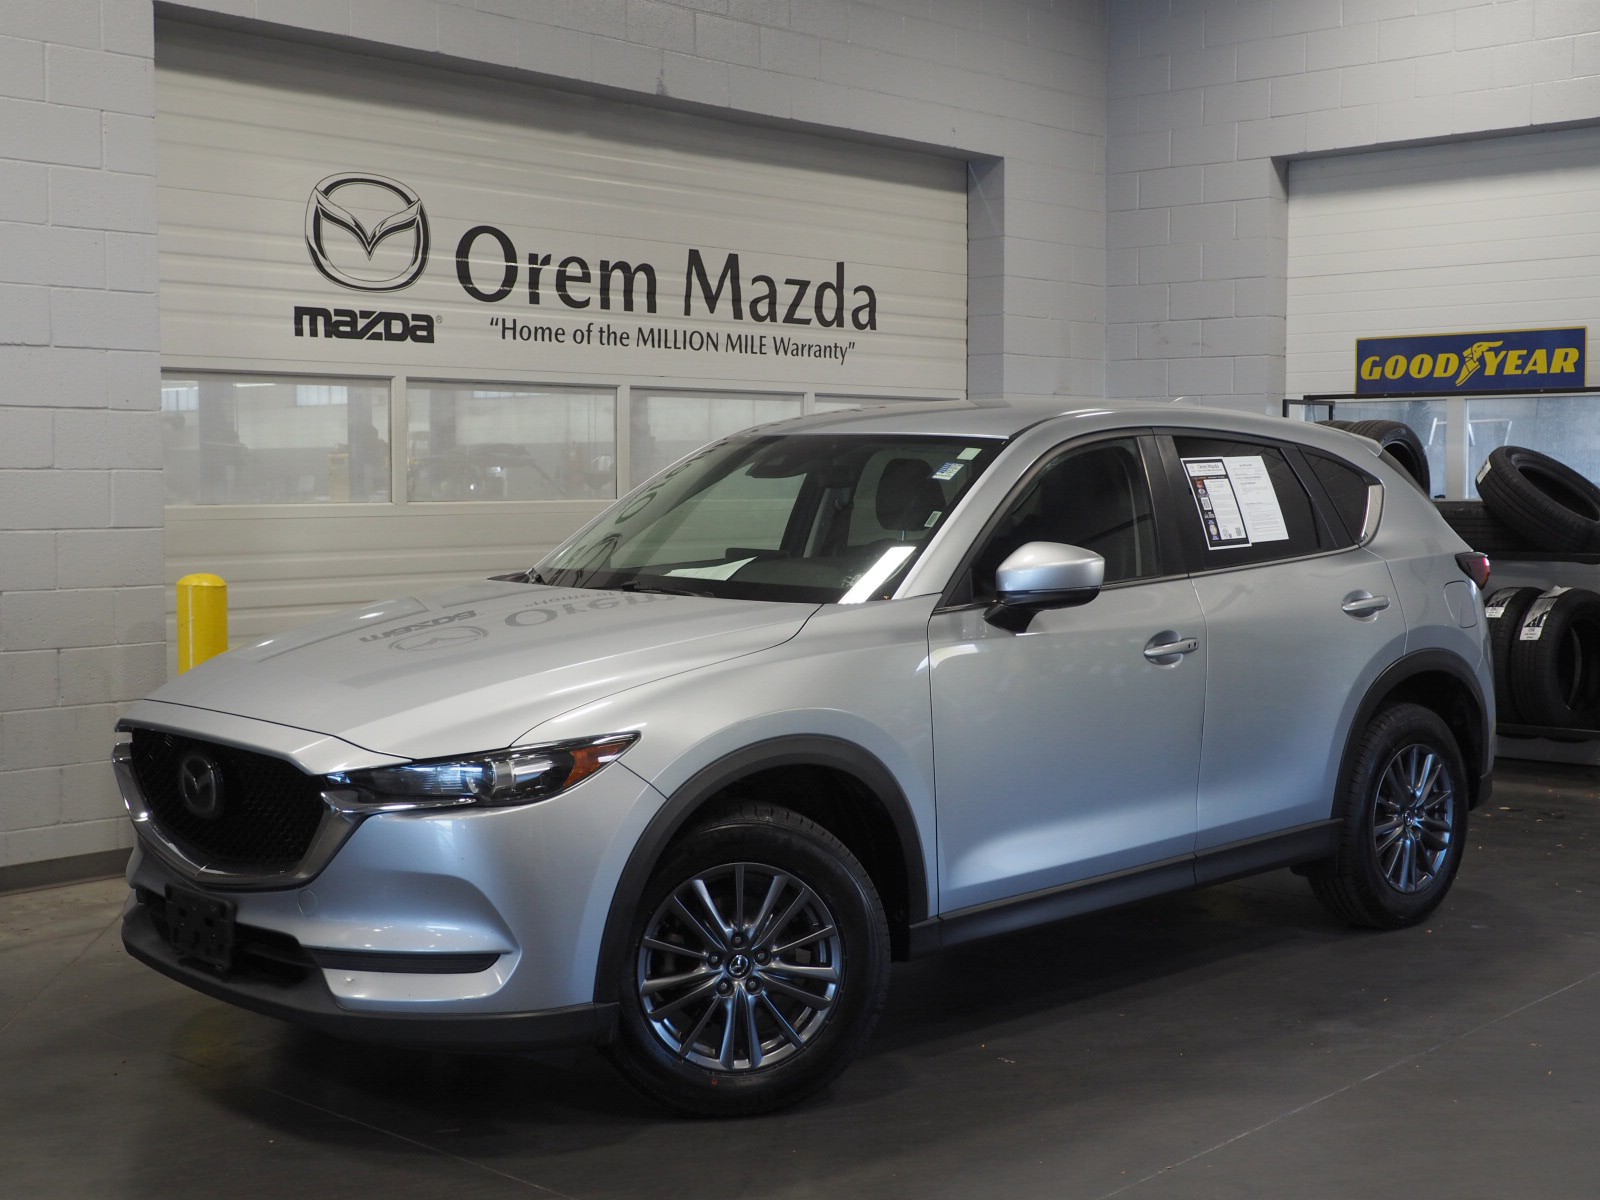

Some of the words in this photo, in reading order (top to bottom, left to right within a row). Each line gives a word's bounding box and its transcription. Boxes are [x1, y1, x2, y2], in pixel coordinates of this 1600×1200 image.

[456, 225, 657, 314] Orem
[683, 248, 878, 331] Mazda
[572, 322, 594, 345] of
[598, 324, 630, 347] the
[636, 326, 719, 352] MILLION
[725, 333, 768, 356] MILE
